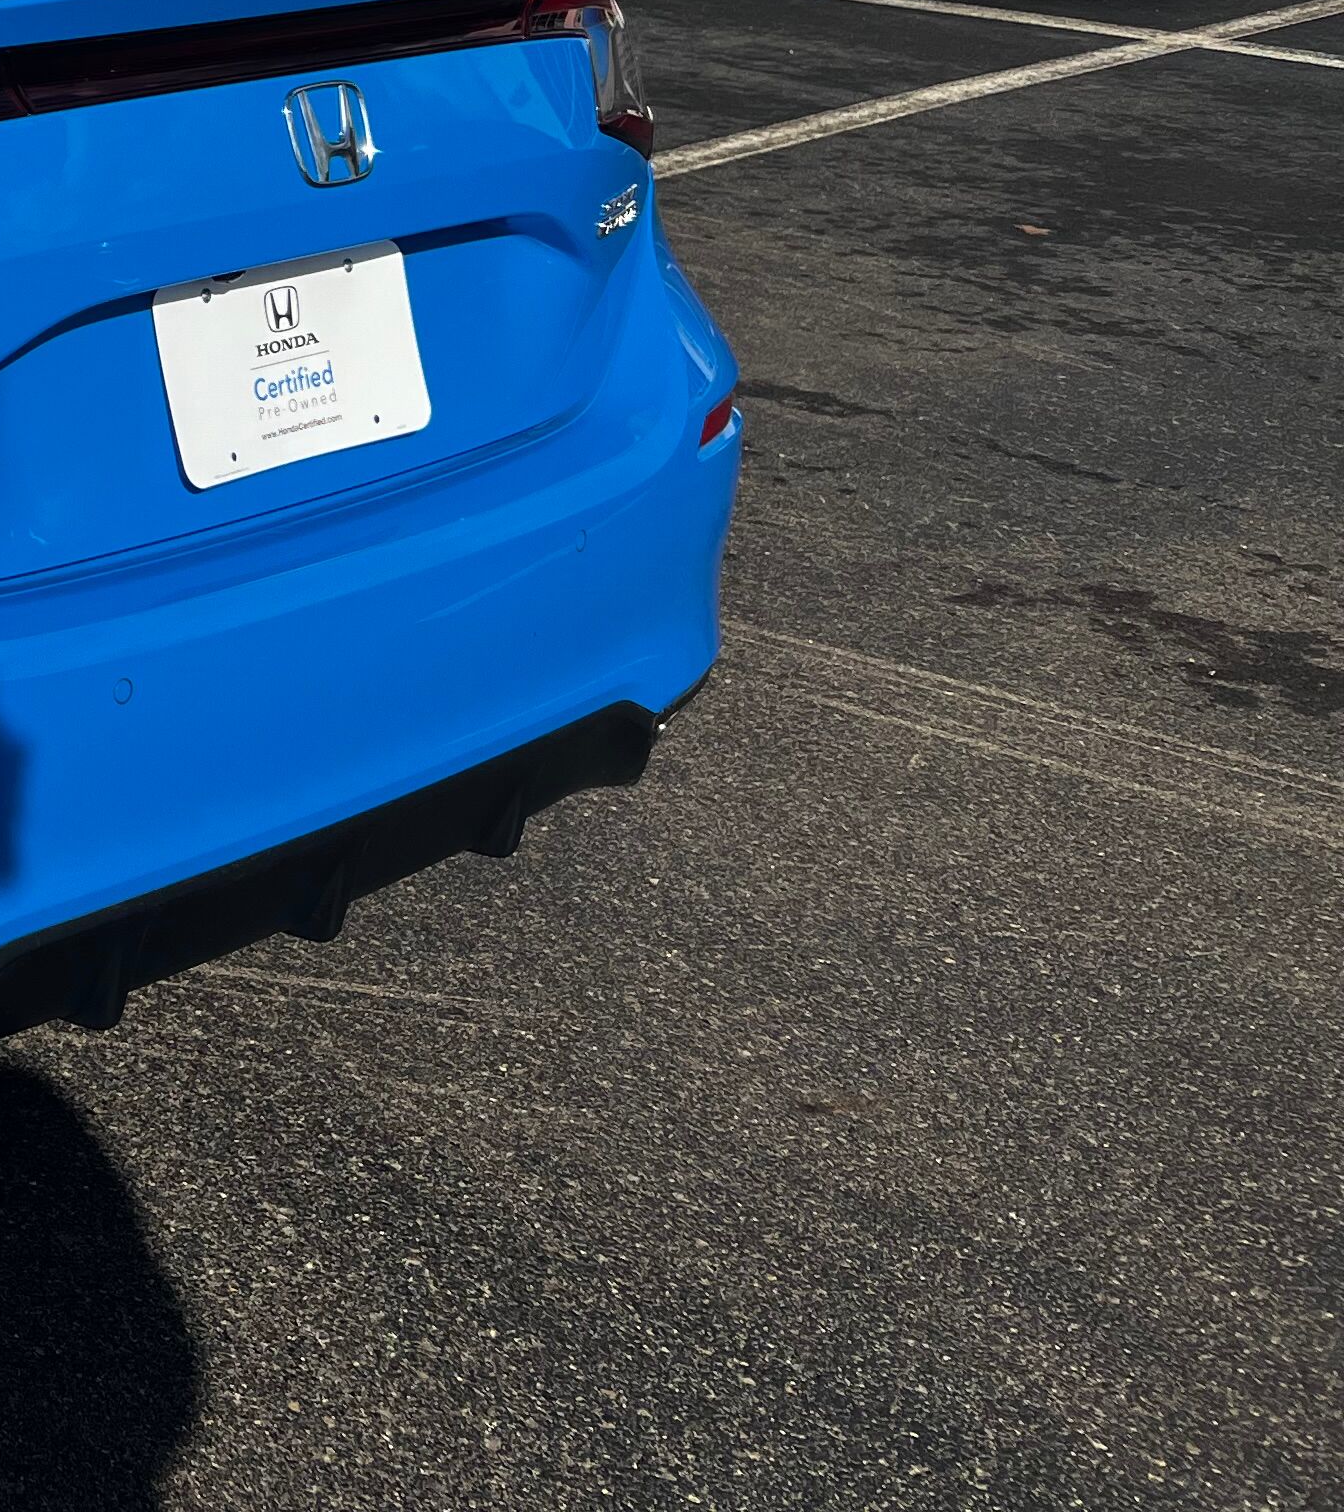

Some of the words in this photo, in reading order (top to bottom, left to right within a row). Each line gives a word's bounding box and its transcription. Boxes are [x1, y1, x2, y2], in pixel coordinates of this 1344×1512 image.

[255, 332, 320, 357] HONDA
[254, 359, 334, 402] Certified
[258, 387, 337, 421] Pre-Owned
[261, 414, 343, 440] www.HondaCertified.com
